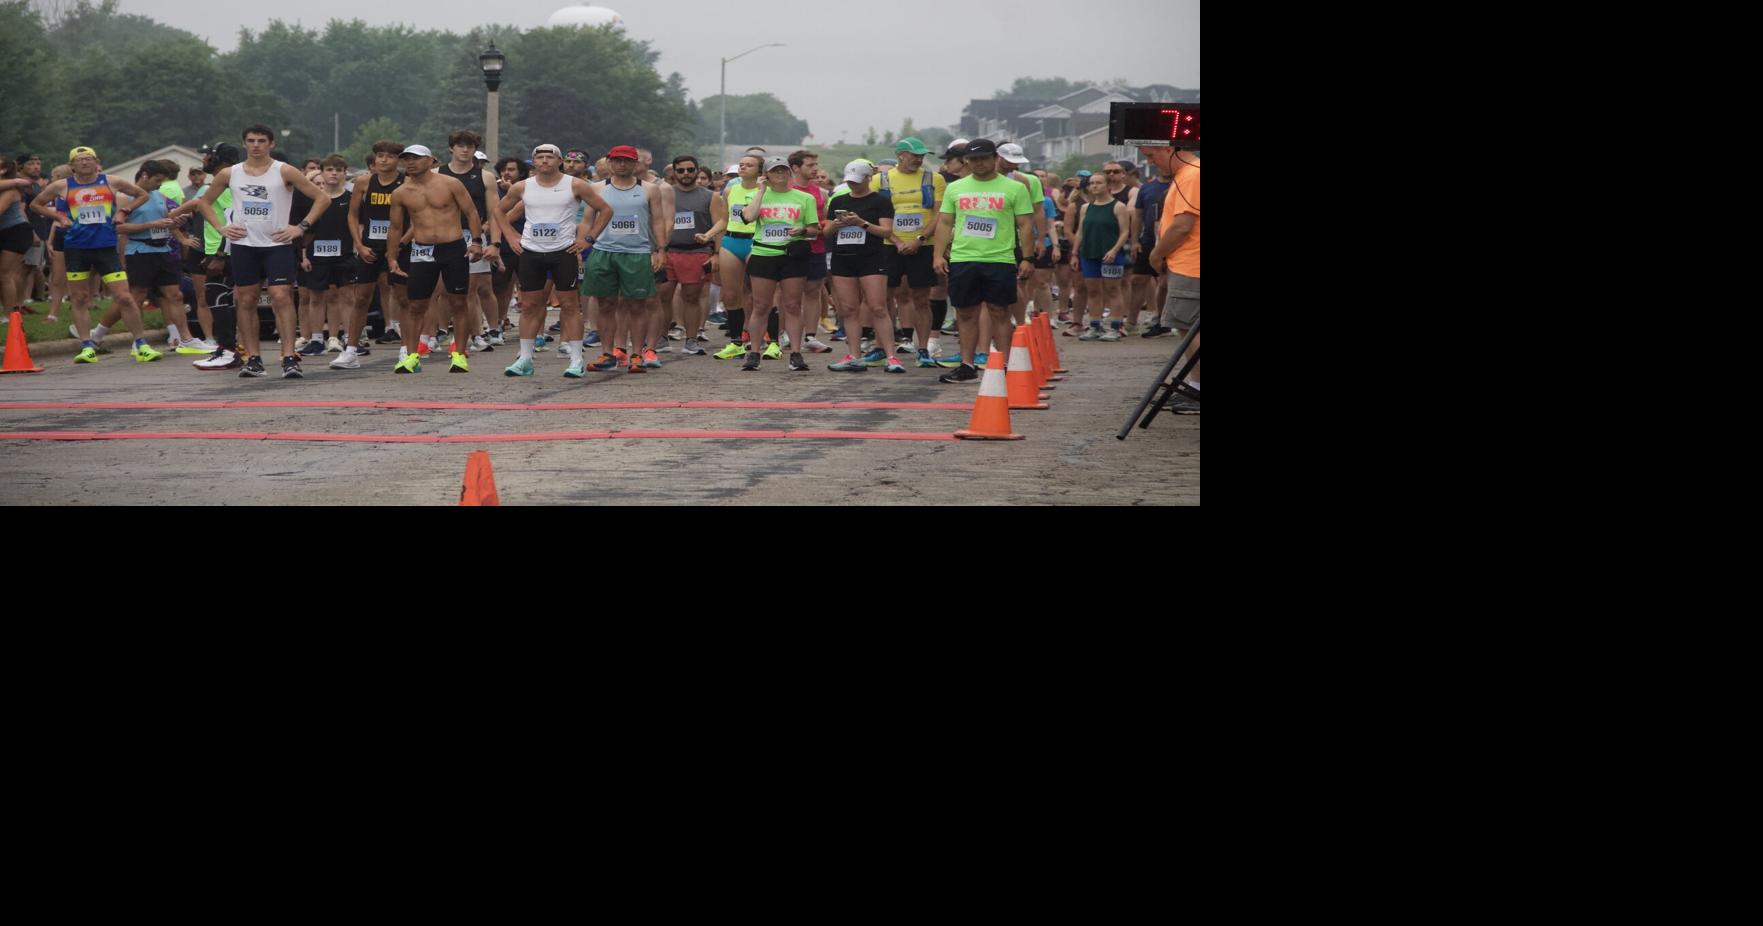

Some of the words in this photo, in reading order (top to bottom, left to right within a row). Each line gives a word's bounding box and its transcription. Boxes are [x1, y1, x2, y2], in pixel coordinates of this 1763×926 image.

[1161, 110, 1193, 138] 7:
[80, 211, 101, 219] 5111
[244, 206, 269, 216] 5058
[732, 209, 743, 217] 50
[611, 220, 636, 230] 5066
[675, 216, 692, 225] 003
[896, 217, 921, 227] 5026
[372, 225, 388, 234] 519
[967, 220, 994, 232] 5005
[532, 228, 557, 238] 5122
[840, 231, 864, 240] 5090
[316, 244, 338, 253] 5189
